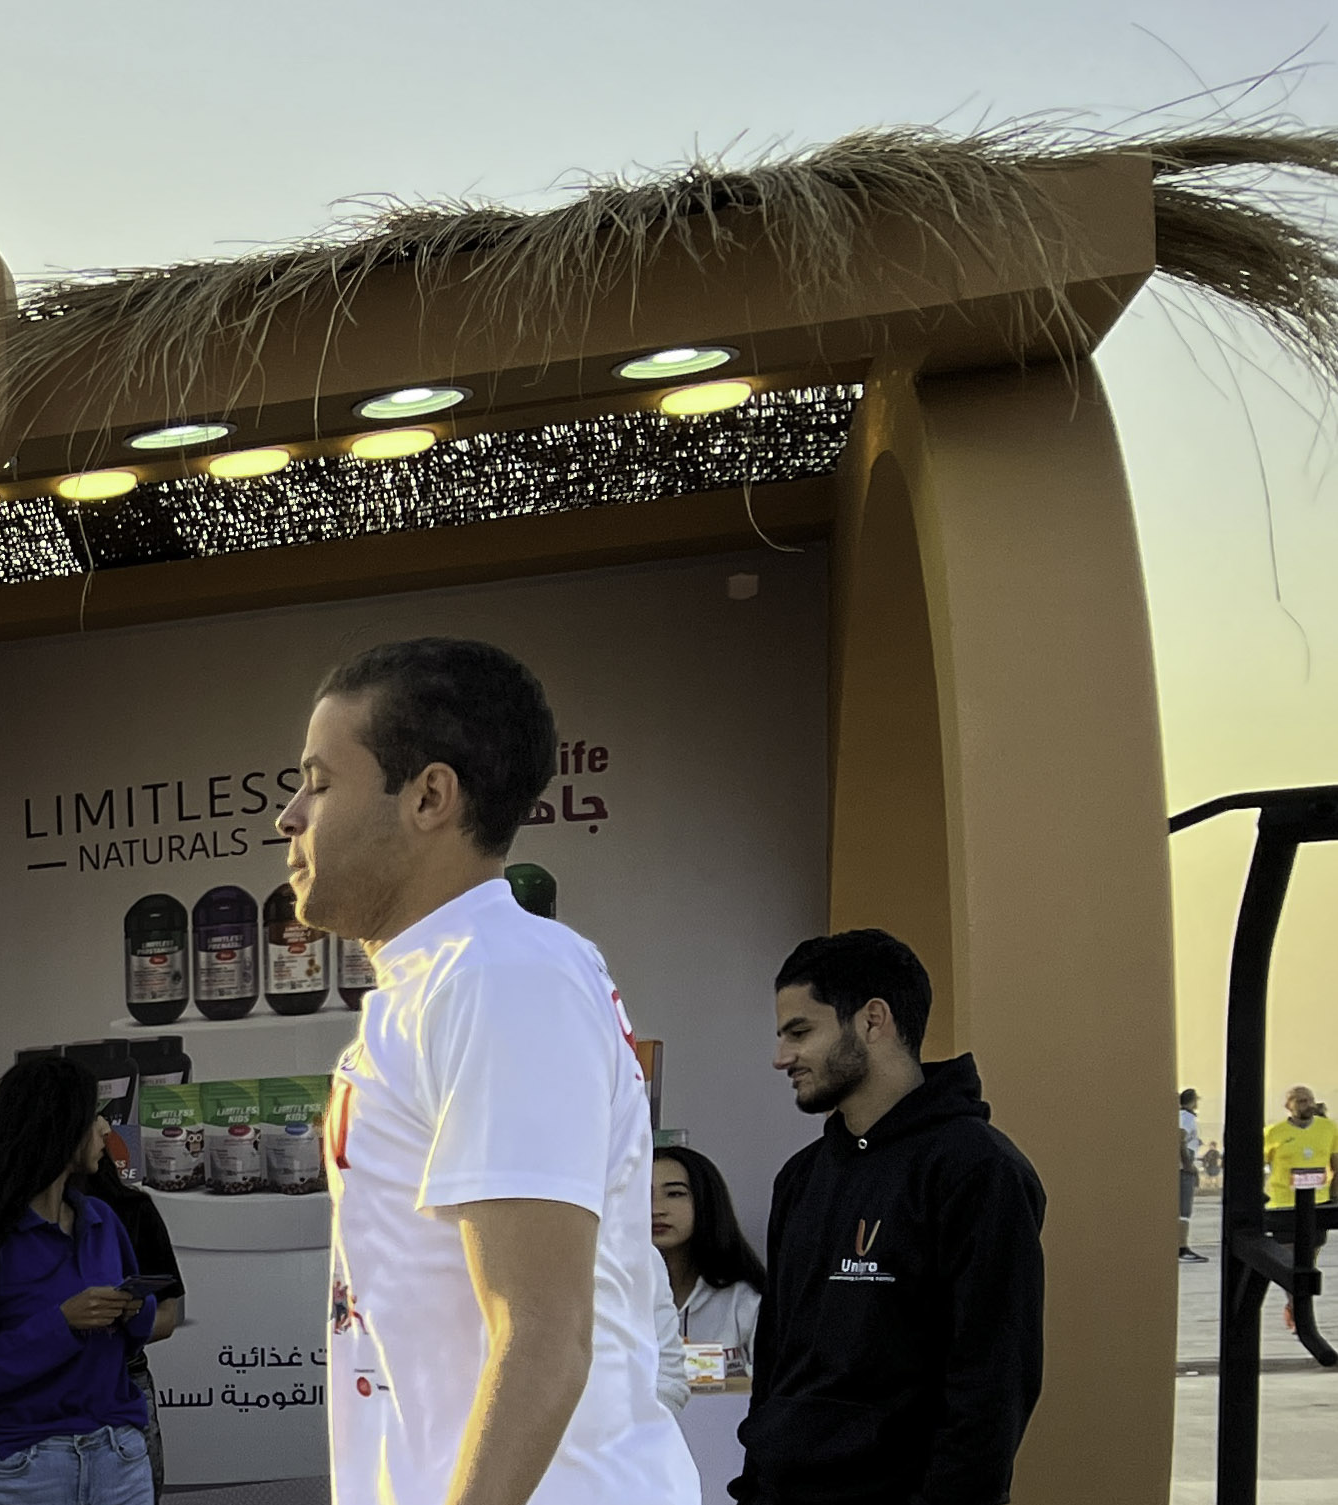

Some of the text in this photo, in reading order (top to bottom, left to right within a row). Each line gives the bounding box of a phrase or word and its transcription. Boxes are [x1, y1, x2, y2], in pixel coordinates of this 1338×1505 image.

[560, 740, 609, 776] ife
[519, 784, 609, 834] جاه
[79, 827, 249, 872] NATURALS
[151, 1108, 195, 1119] LIMITLESS
[161, 1116, 182, 1125] KIDS
[227, 1113, 250, 1123] KIDS
[284, 1112, 307, 1122] KIDS
[158, 1387, 214, 1408] لسلا
